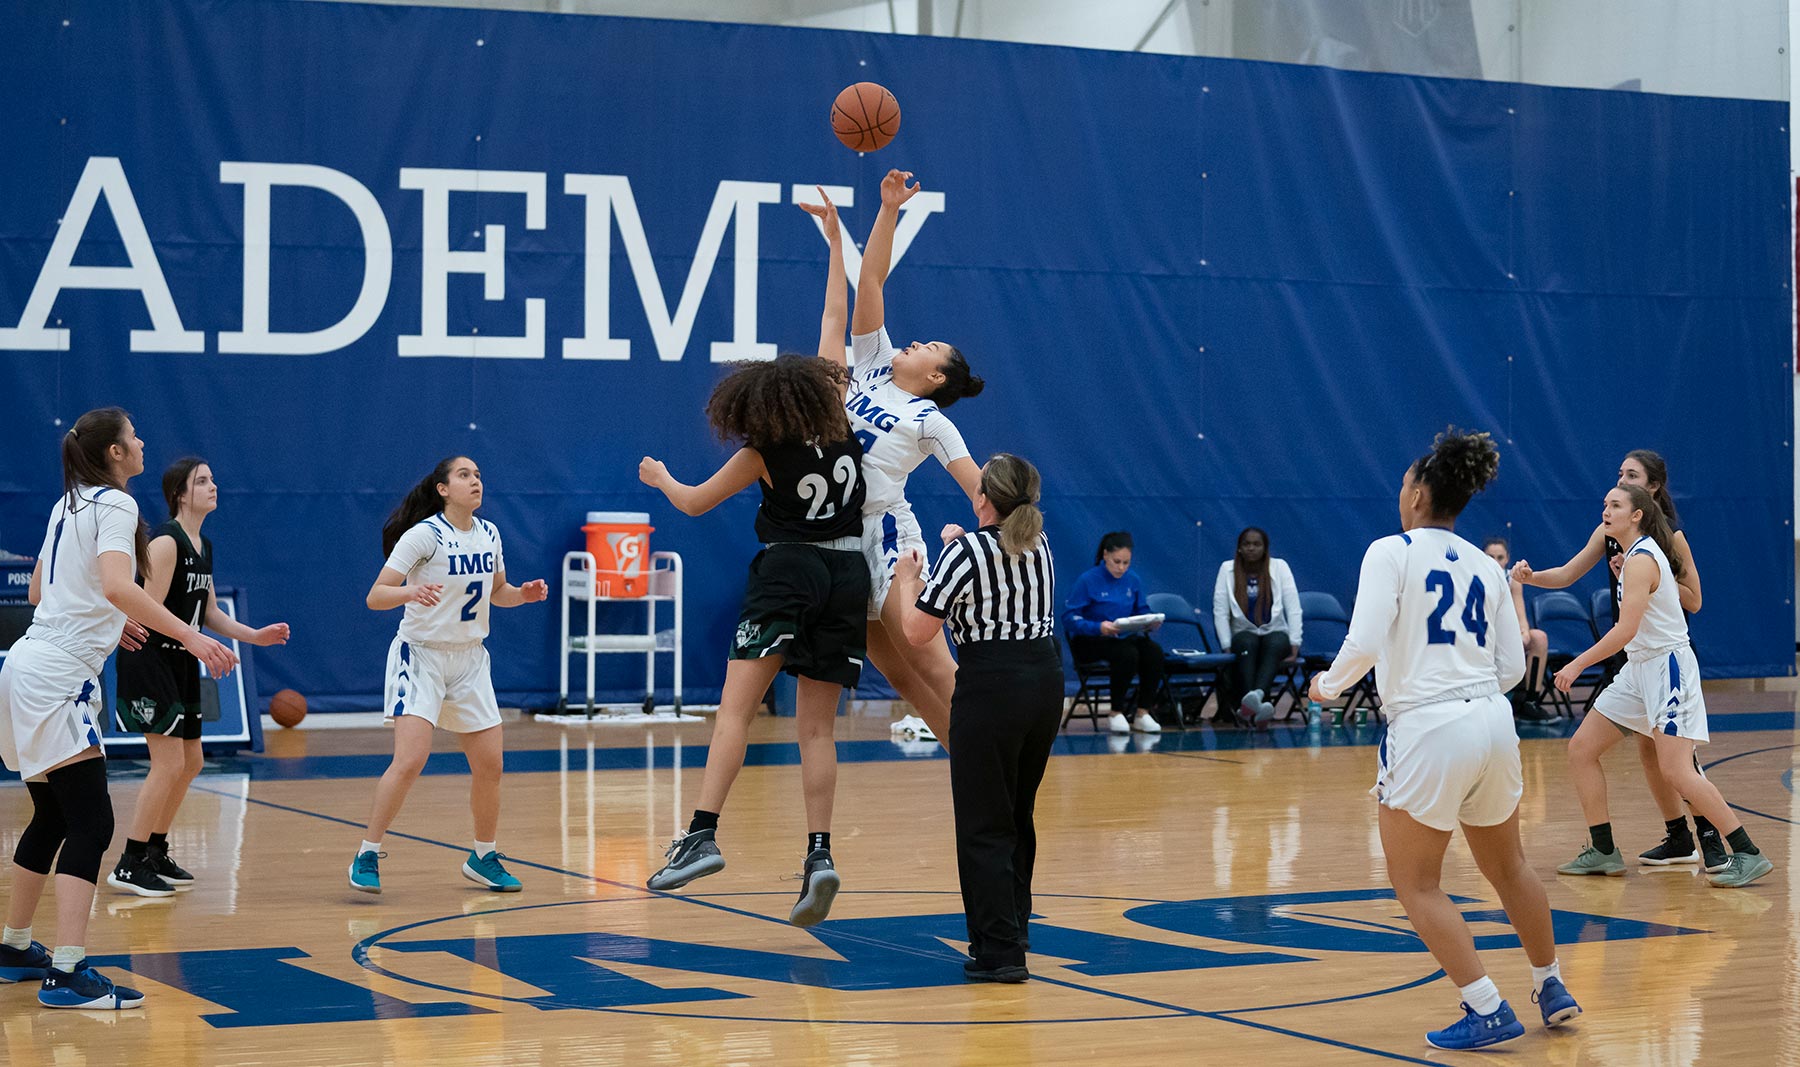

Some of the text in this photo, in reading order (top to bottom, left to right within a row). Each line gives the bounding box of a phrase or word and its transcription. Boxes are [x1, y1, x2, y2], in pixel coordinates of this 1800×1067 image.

[0, 156, 946, 365] ADEMY
[448, 552, 493, 575] IMG
[461, 581, 483, 621] 2
[1425, 569, 1488, 648] 24
